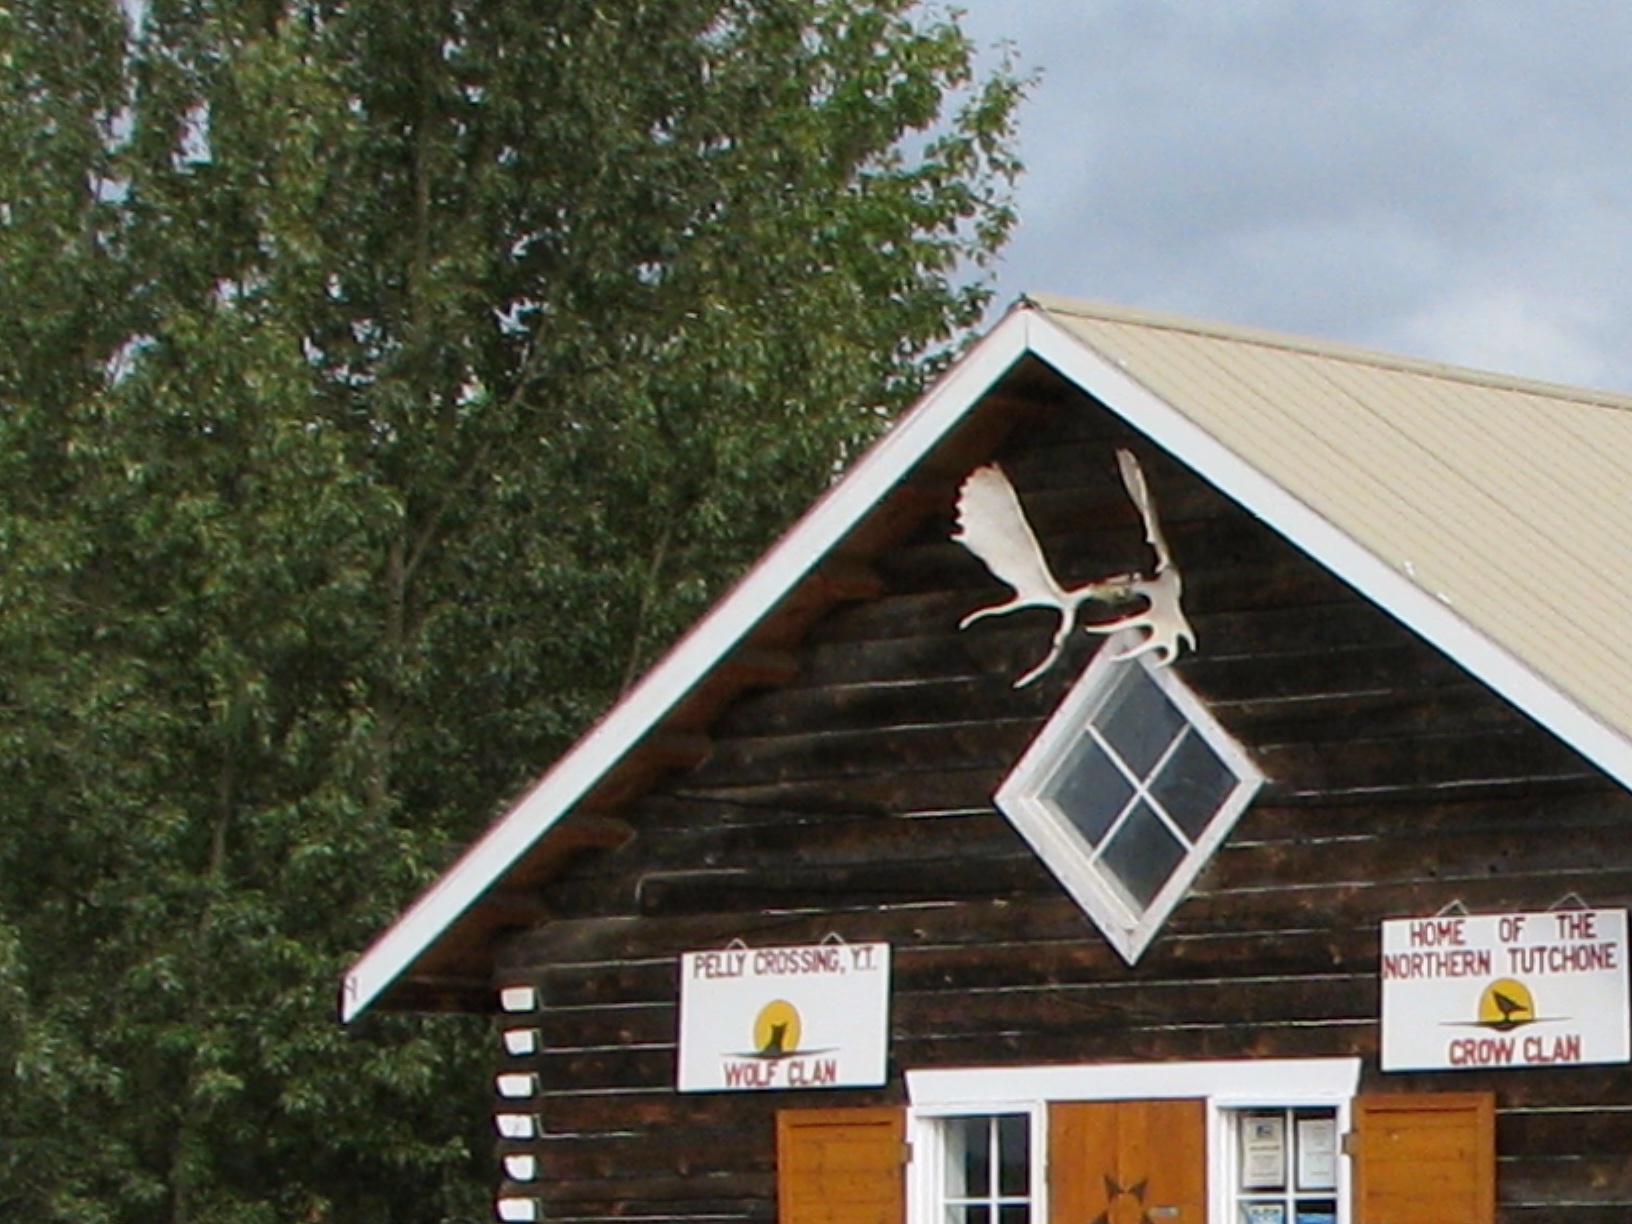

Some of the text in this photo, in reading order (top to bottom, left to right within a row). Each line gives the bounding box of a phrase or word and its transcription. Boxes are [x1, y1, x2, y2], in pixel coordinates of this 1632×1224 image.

[1410, 912, 1597, 946] HOME OF THE
[692, 953, 746, 979] PELLY
[1382, 943, 1617, 980] NORTHERN TUTCHONE
[1449, 1034, 1581, 1066] CROW CLAN
[723, 1059, 836, 1088] WOLF CLAN
